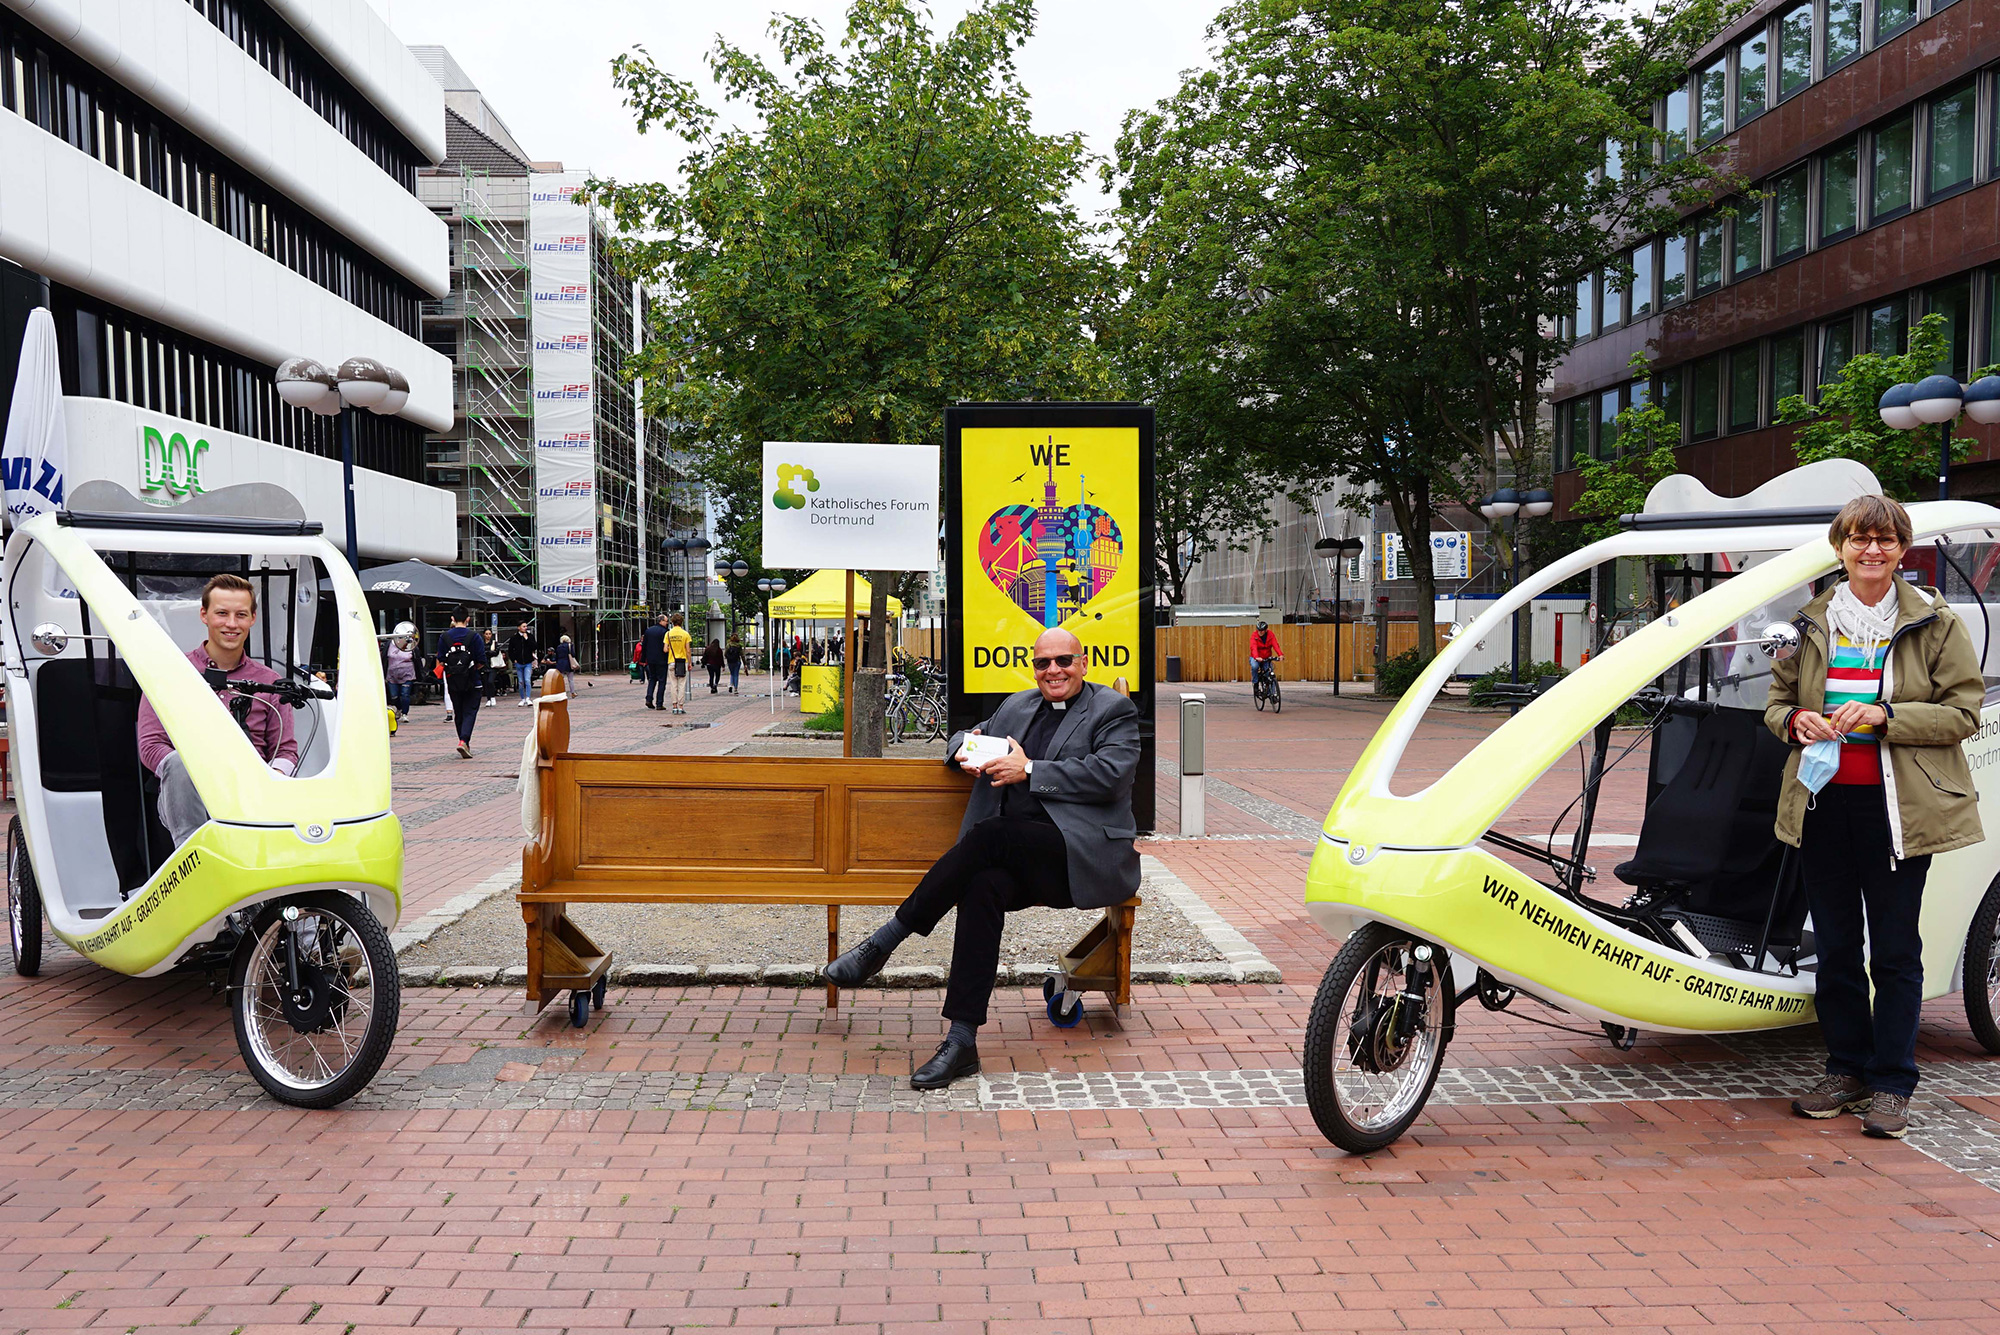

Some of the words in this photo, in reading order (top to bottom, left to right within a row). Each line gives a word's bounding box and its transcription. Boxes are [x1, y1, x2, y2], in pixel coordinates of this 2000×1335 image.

[532, 193, 574, 201] WEIS
[560, 236, 587, 244] 125
[533, 243, 586, 251] WEISE
[534, 292, 587, 301] WEISE
[536, 341, 588, 350] WEISE
[537, 391, 589, 399] WEISE
[1029, 444, 1071, 467] WE
[143, 425, 210, 496] DOC
[565, 481, 592, 489] 125
[540, 488, 591, 496] WEISE
[810, 498, 888, 510] Katholisches
[890, 499, 930, 511] Forum
[810, 513, 875, 526] Dortmund
[540, 537, 592, 545] WEISE
[567, 578, 594, 586] 125
[542, 585, 593, 593] WEISE
[973, 646, 1130, 668] DORND
[85, 933, 107, 953] NEHMEN
[103, 922, 122, 949] FAHRT
[120, 914, 133, 936] AUF
[136, 889, 162, 923] GRATIS!
[159, 870, 181, 901] FAHR
[178, 849, 201, 881] MIT!
[1482, 874, 1519, 911] WIR
[1519, 898, 1592, 951] NEHMEN
[1591, 938, 1643, 972] FAHRT
[1641, 960, 1674, 984] AUF
[1683, 974, 1737, 1003] GRATIS!
[1738, 989, 1775, 1011] FAHR
[1774, 996, 1806, 1014] MIT!
